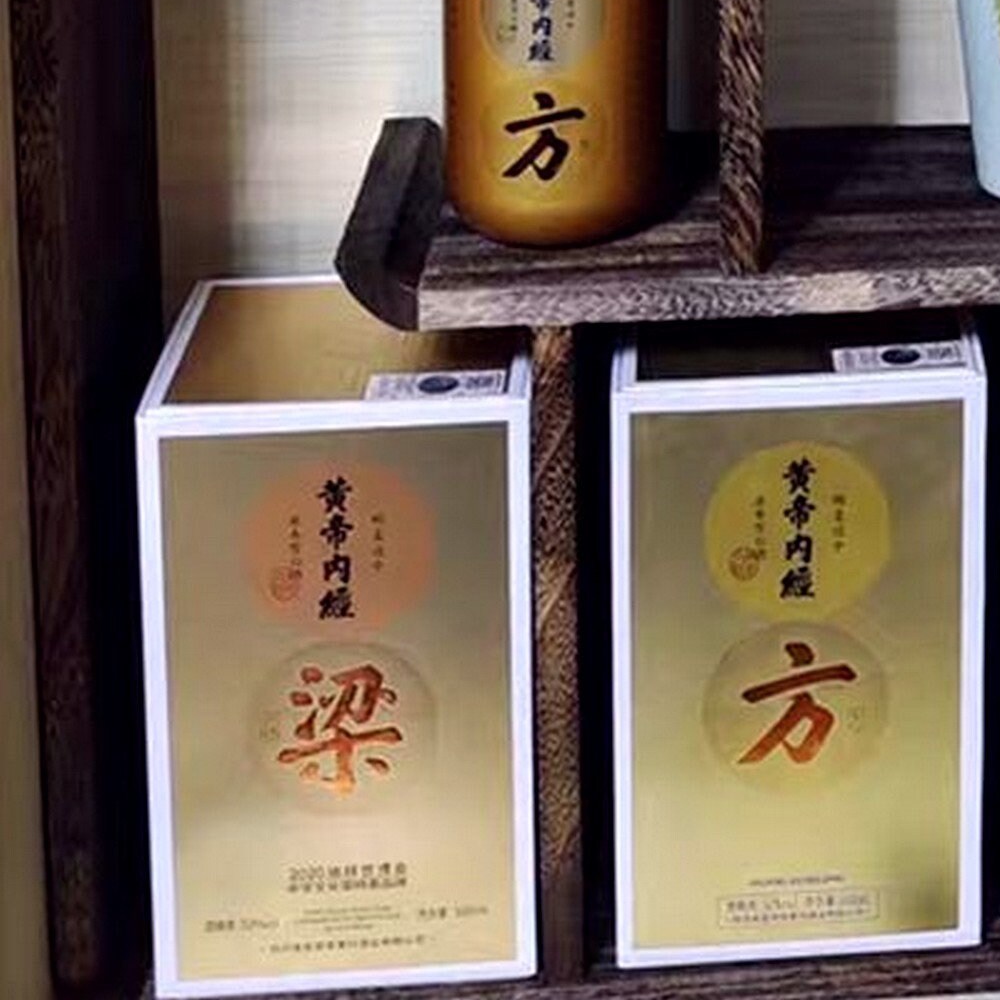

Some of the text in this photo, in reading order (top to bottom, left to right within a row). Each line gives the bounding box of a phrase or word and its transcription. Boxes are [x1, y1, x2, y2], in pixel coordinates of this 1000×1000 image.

[502, 91, 586, 181] 方
[277, 663, 403, 796] 梁
[736, 641, 858, 765] 方
